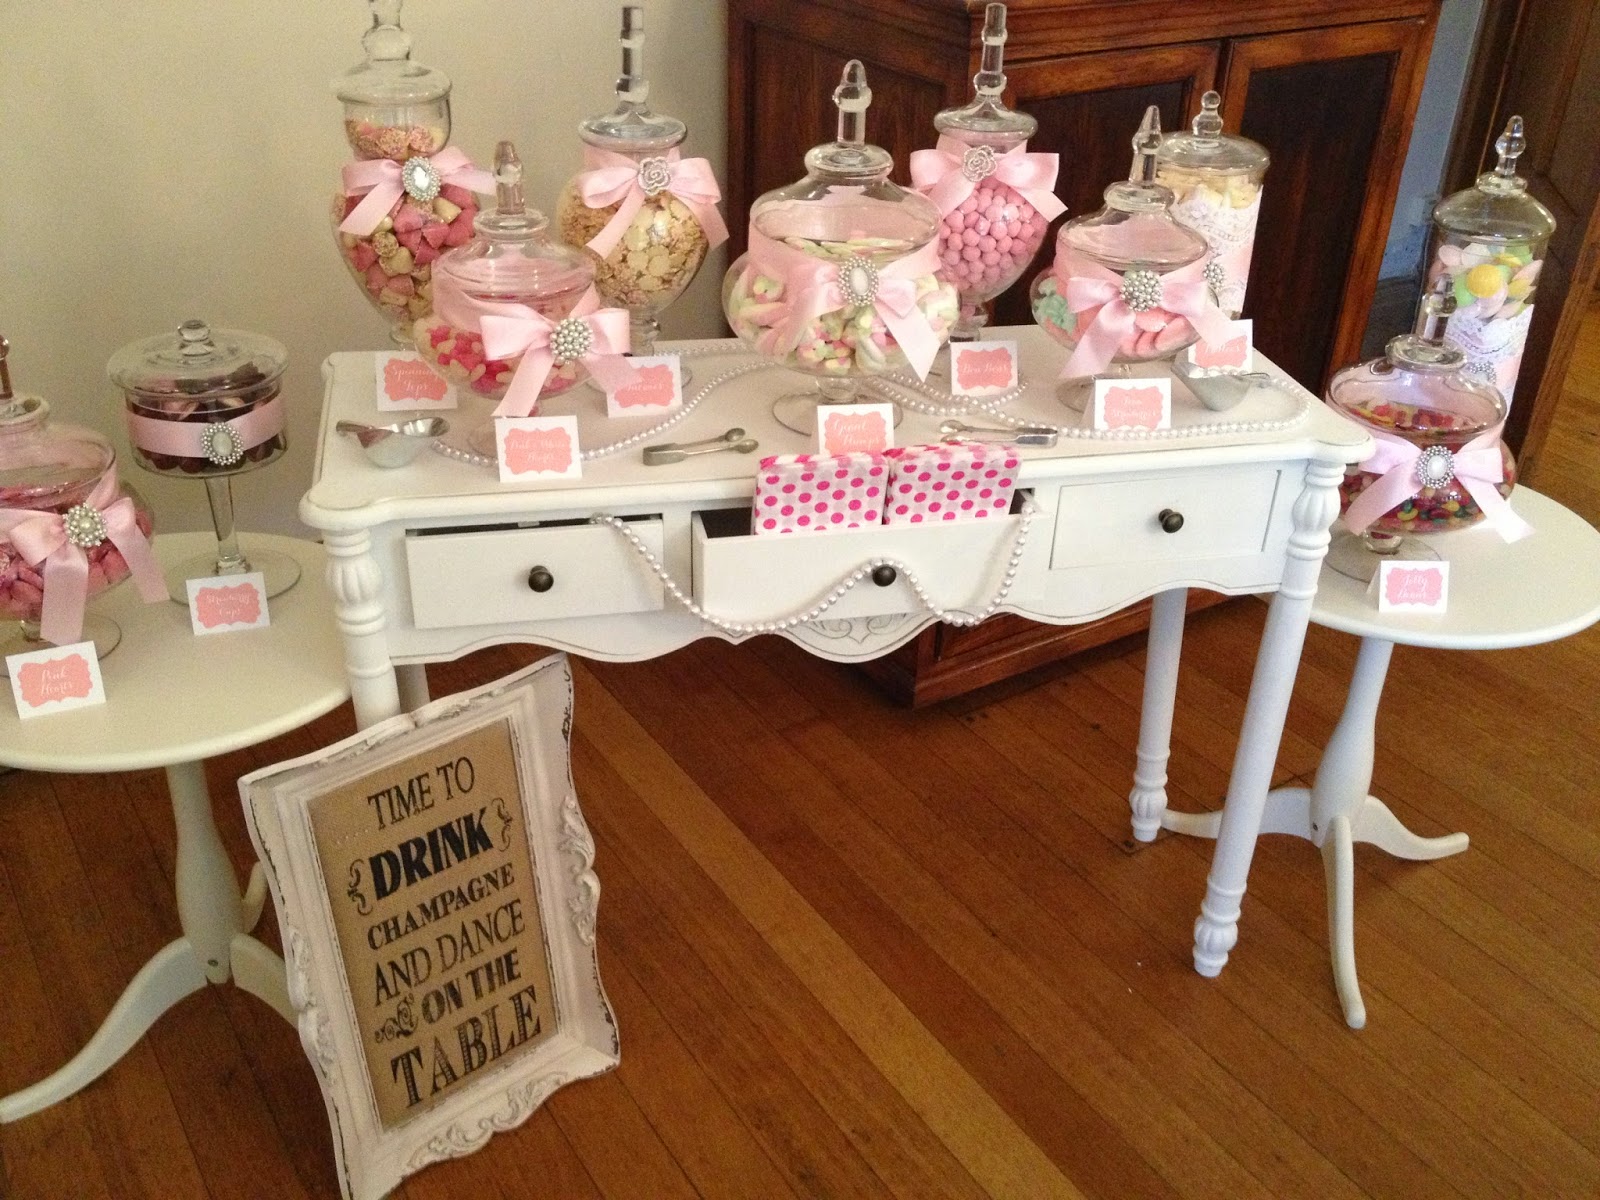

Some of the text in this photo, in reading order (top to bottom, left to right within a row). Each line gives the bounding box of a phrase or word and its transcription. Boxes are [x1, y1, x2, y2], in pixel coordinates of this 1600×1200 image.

[1403, 574, 1428, 592] Jelly
[41, 664, 68, 682] Pink
[367, 756, 475, 830] TIME TO
[369, 807, 494, 900] DRINK
[367, 862, 515, 951] CHAMPAGNE
[374, 898, 526, 1007] AND DANCE
[421, 947, 522, 1025] ON THE
[390, 984, 542, 1109] TABLE
